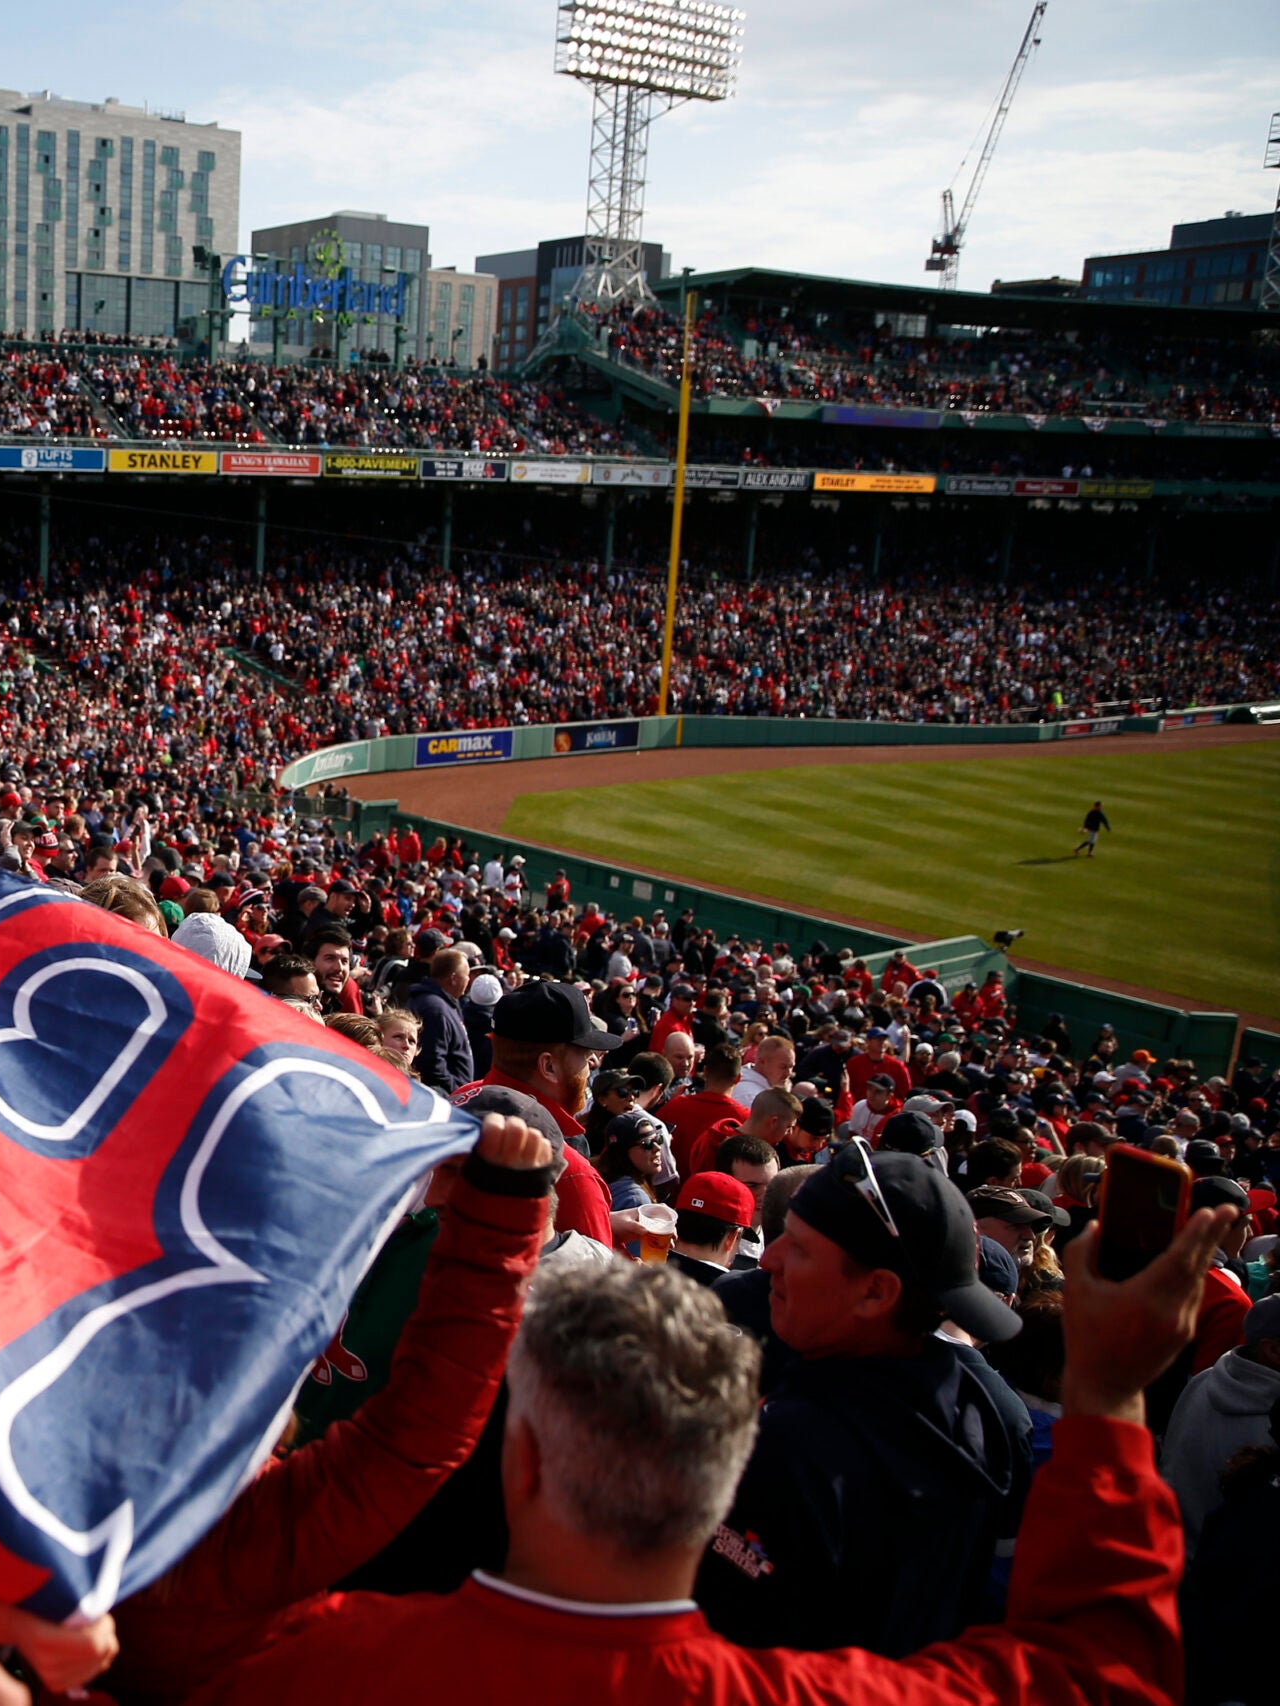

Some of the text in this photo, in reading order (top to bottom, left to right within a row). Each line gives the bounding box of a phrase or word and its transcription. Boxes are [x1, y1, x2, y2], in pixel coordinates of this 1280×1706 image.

[223, 256, 406, 317] Cumberland
[261, 304, 375, 325] FARMS
[39, 449, 73, 461] TUFTS
[128, 453, 202, 469] STANLEY
[326, 456, 416, 470] 1-800-PAVEMENT
